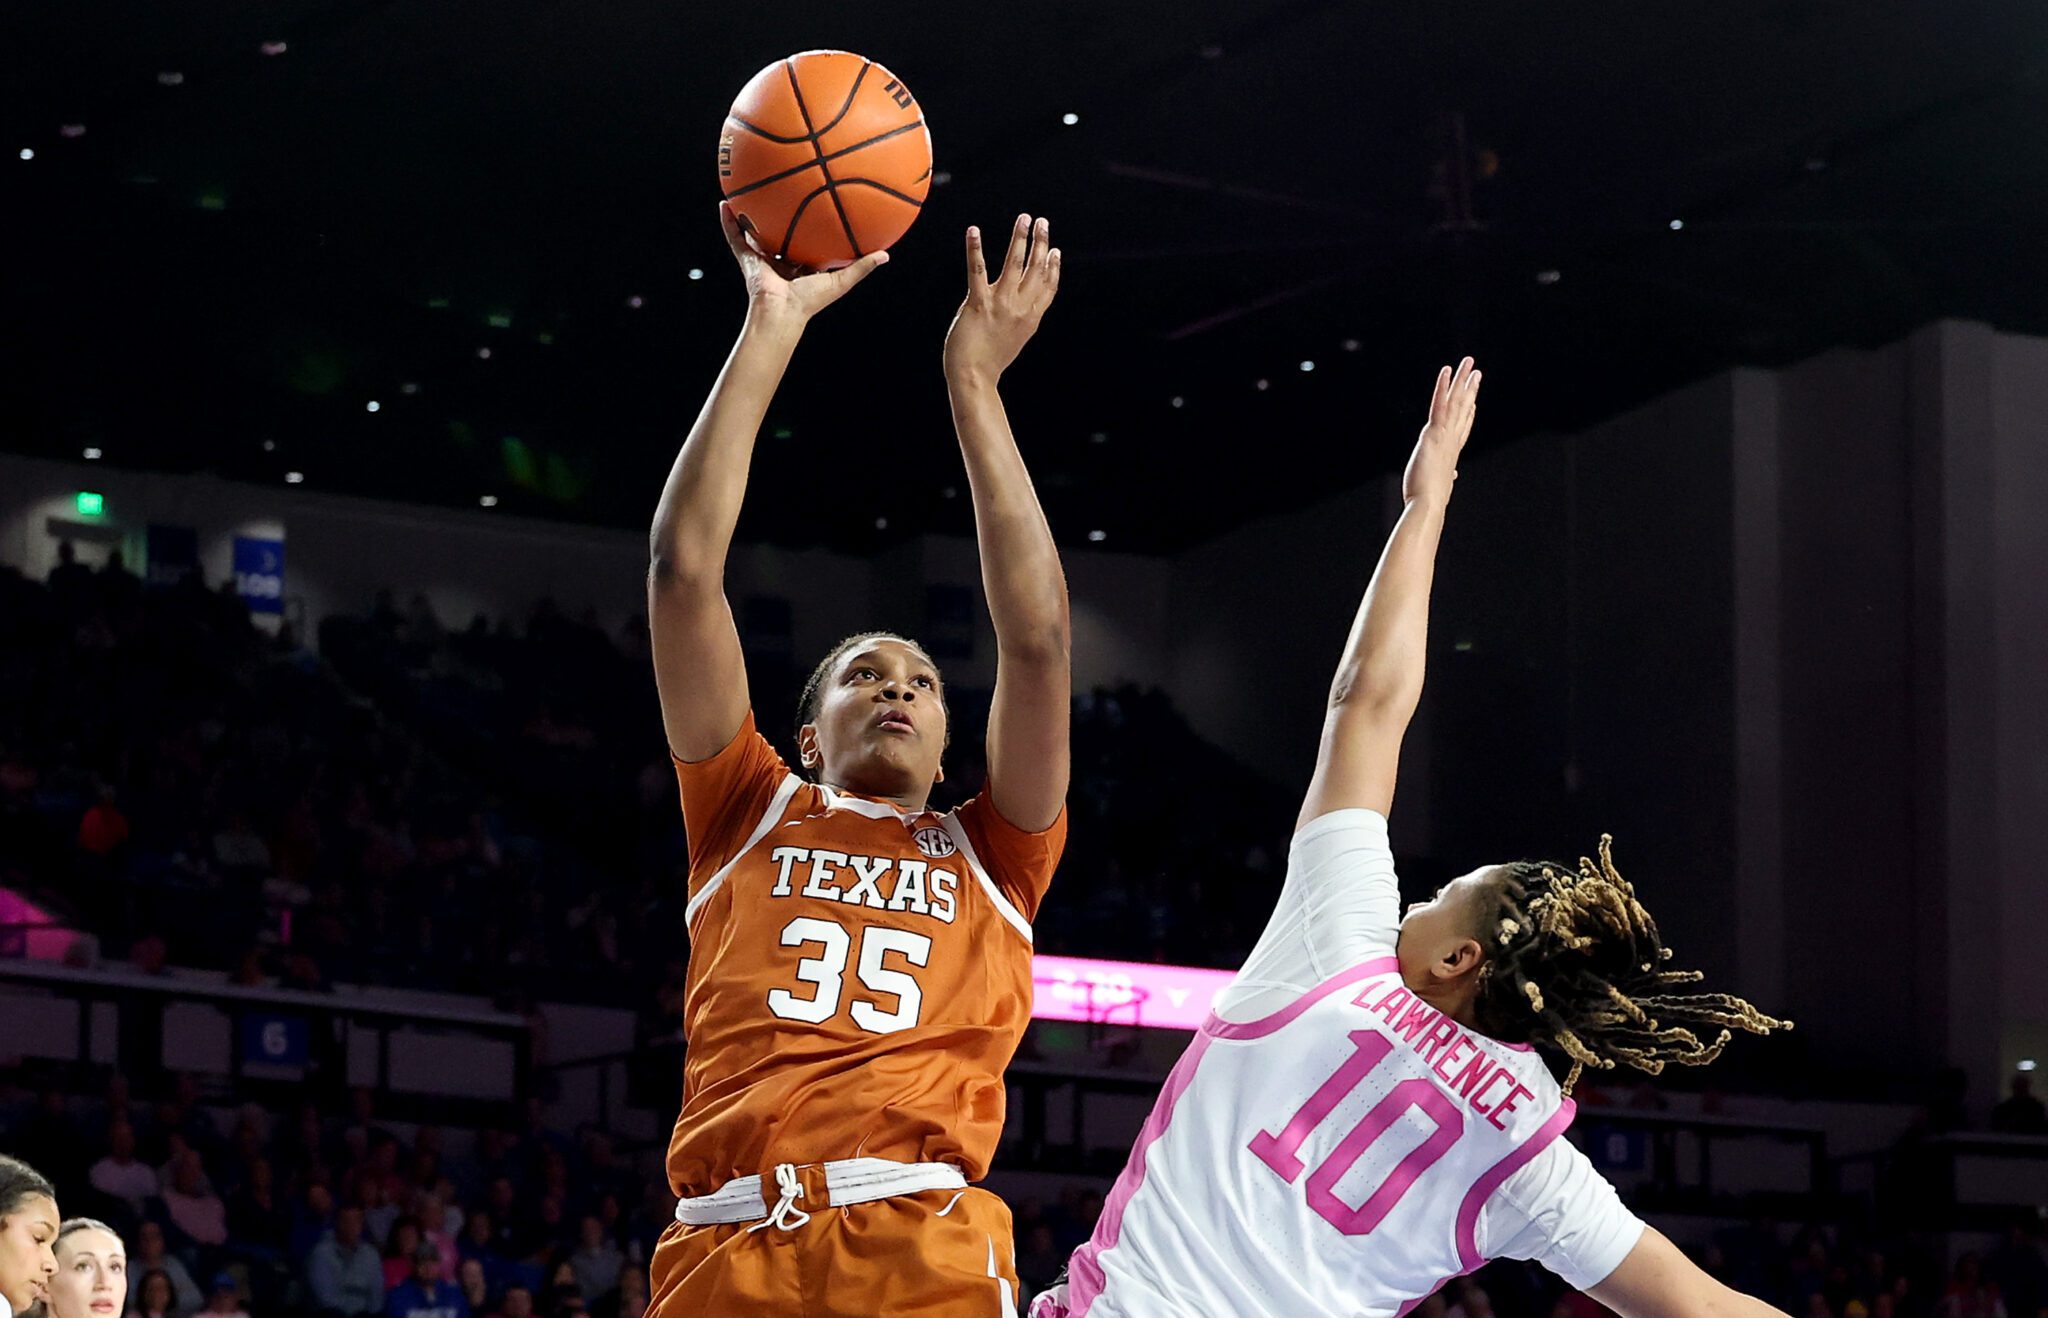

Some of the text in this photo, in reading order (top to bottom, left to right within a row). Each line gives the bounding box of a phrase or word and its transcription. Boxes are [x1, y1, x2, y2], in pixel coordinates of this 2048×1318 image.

[770, 845, 959, 925] TEXAS
[914, 828, 955, 857] SEC
[767, 915, 933, 1035] 35
[261, 1020, 289, 1057] 6
[1350, 980, 1535, 1131] LAWRENCE
[1246, 1029, 1464, 1236] 10
